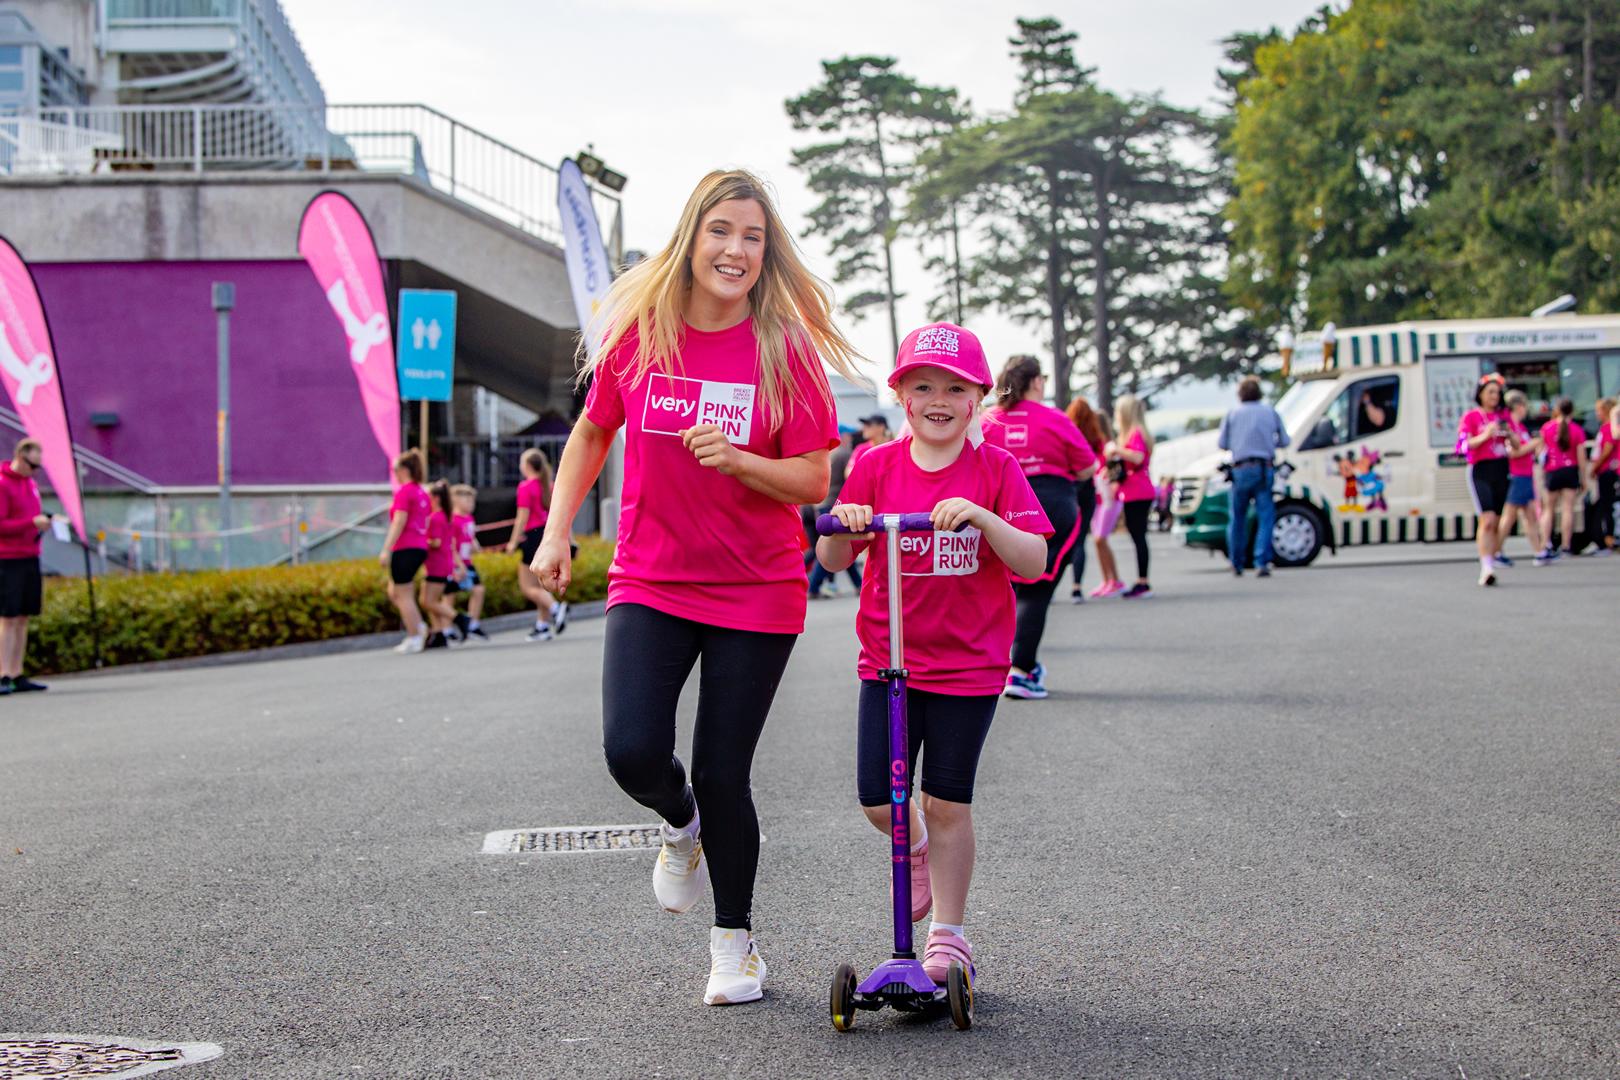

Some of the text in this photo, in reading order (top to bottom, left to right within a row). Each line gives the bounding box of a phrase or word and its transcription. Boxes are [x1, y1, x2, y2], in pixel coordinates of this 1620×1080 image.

[914, 342, 959, 352] IRELAND
[916, 335, 959, 346] CANCER
[651, 394, 696, 418] very
[703, 402, 748, 421] PINK
[900, 536, 977, 557] ery PINK
[939, 553, 973, 569] RUN
